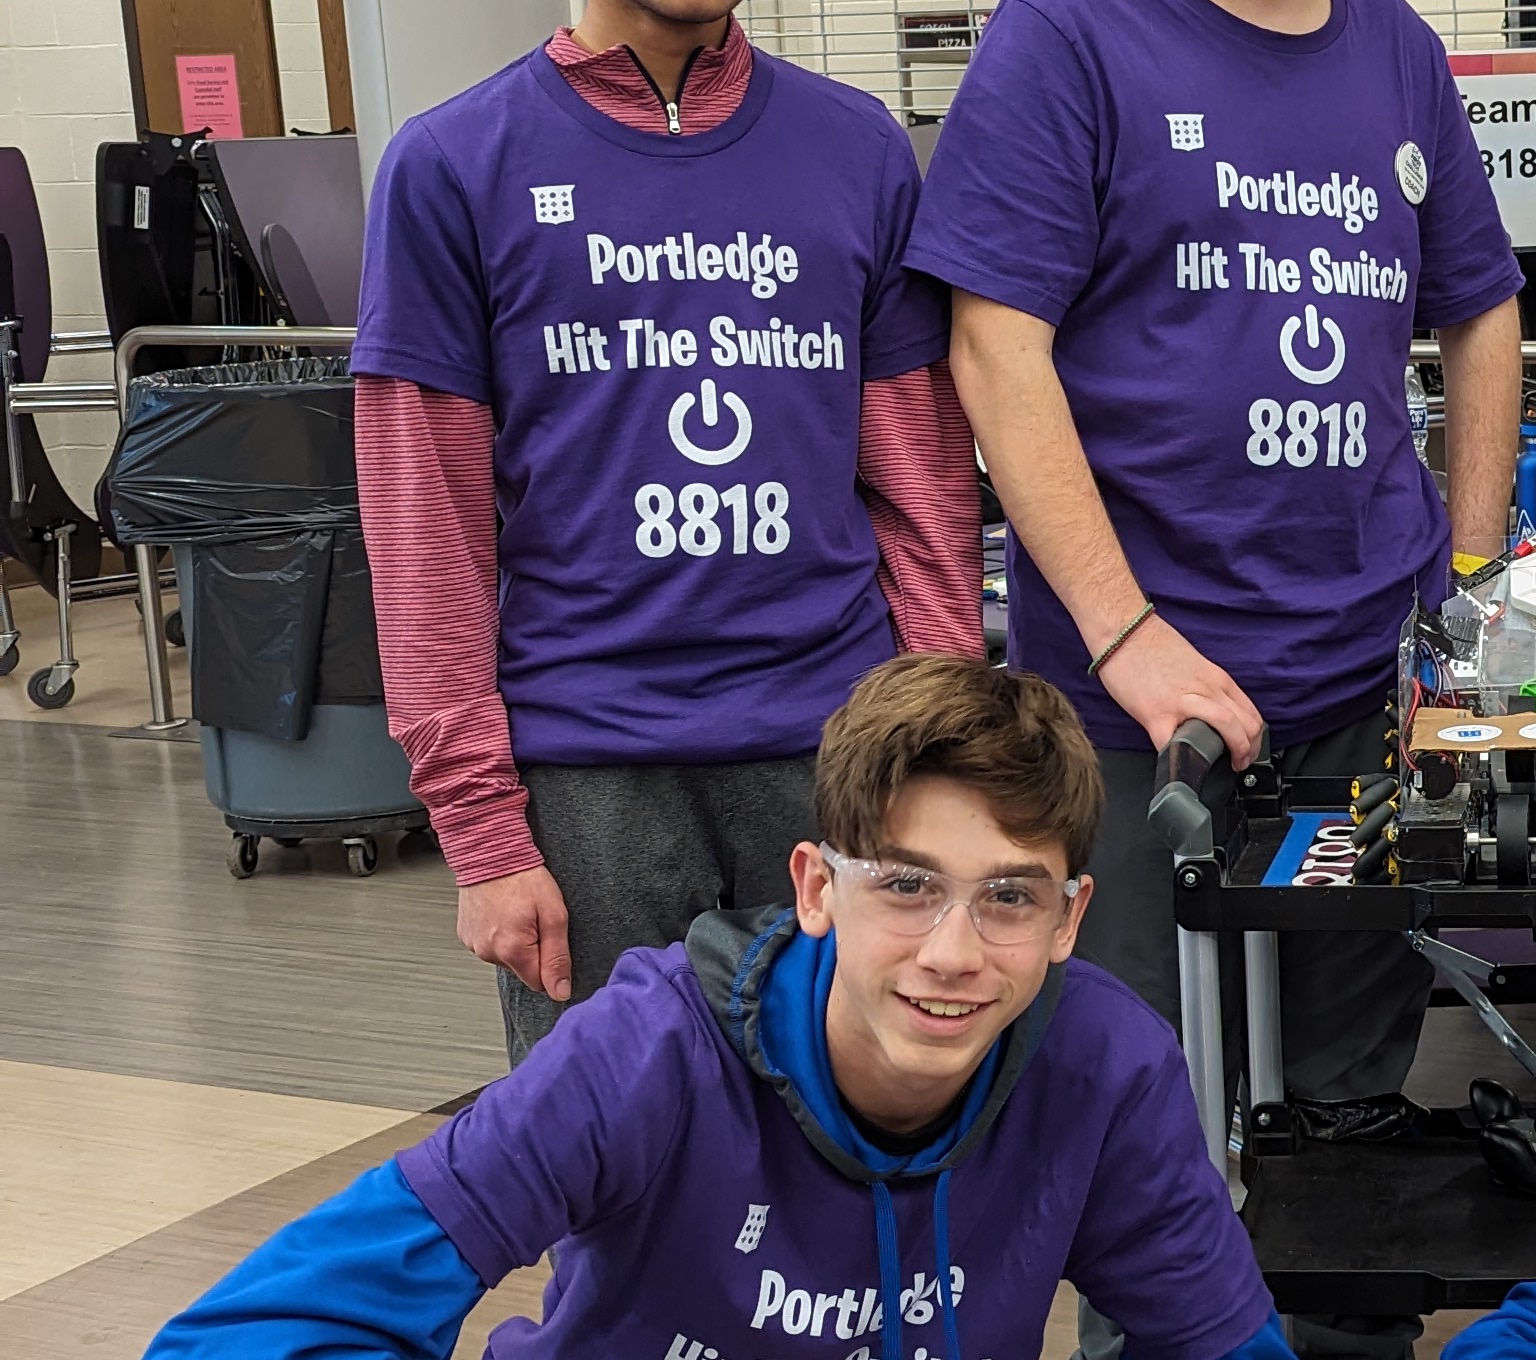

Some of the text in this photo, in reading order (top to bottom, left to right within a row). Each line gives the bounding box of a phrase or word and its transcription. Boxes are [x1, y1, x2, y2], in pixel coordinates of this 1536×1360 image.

[937, 38, 967, 48] PIZZA
[1216, 162, 1378, 234] Portledge
[587, 232, 799, 299] Portledge
[1176, 241, 1407, 303] Hit The Switch
[544, 316, 844, 373] Hit The Switch
[1246, 398, 1367, 467] 8818
[634, 482, 791, 558] 8818
